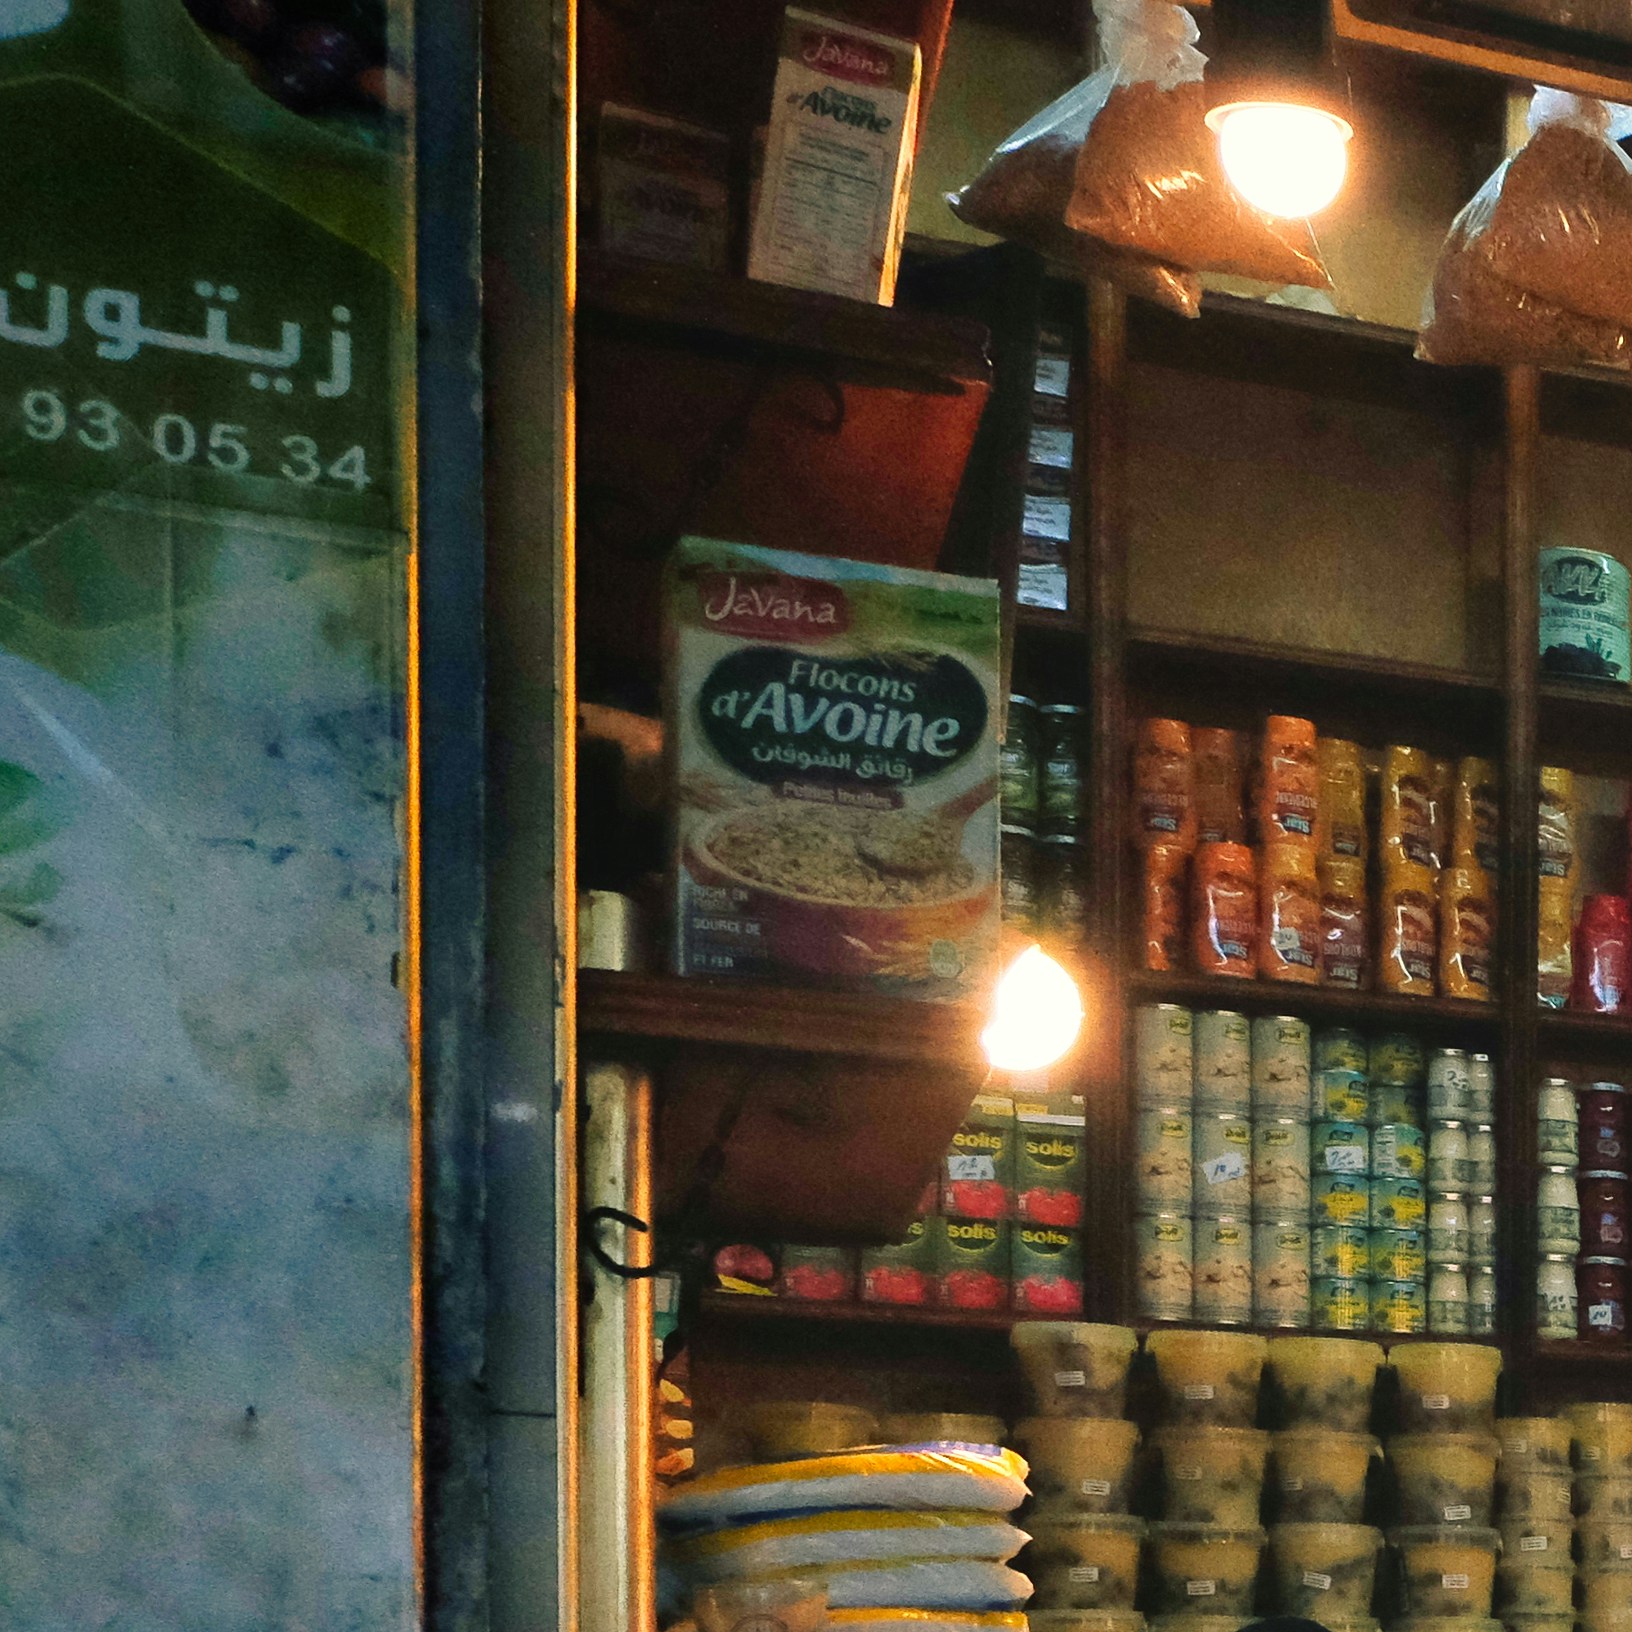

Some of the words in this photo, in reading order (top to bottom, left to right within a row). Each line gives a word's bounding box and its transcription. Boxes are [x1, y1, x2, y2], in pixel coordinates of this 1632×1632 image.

[0, 271, 352, 398] زيتون
[23, 389, 121, 451] 93
[151, 413, 251, 473] 05
[280, 435, 373, 492] 34
[703, 576, 838, 626] Javana
[789, 658, 918, 701] Flocons
[710, 680, 961, 758] d'Avoine
[751, 742, 852, 771] الشوفان
[855, 755, 914, 785] رقائق
[951, 1131, 1002, 1149] solis
[1025, 1139, 1076, 1158] solis
[948, 1222, 998, 1239] solis
[1020, 1229, 1071, 1245] solis
